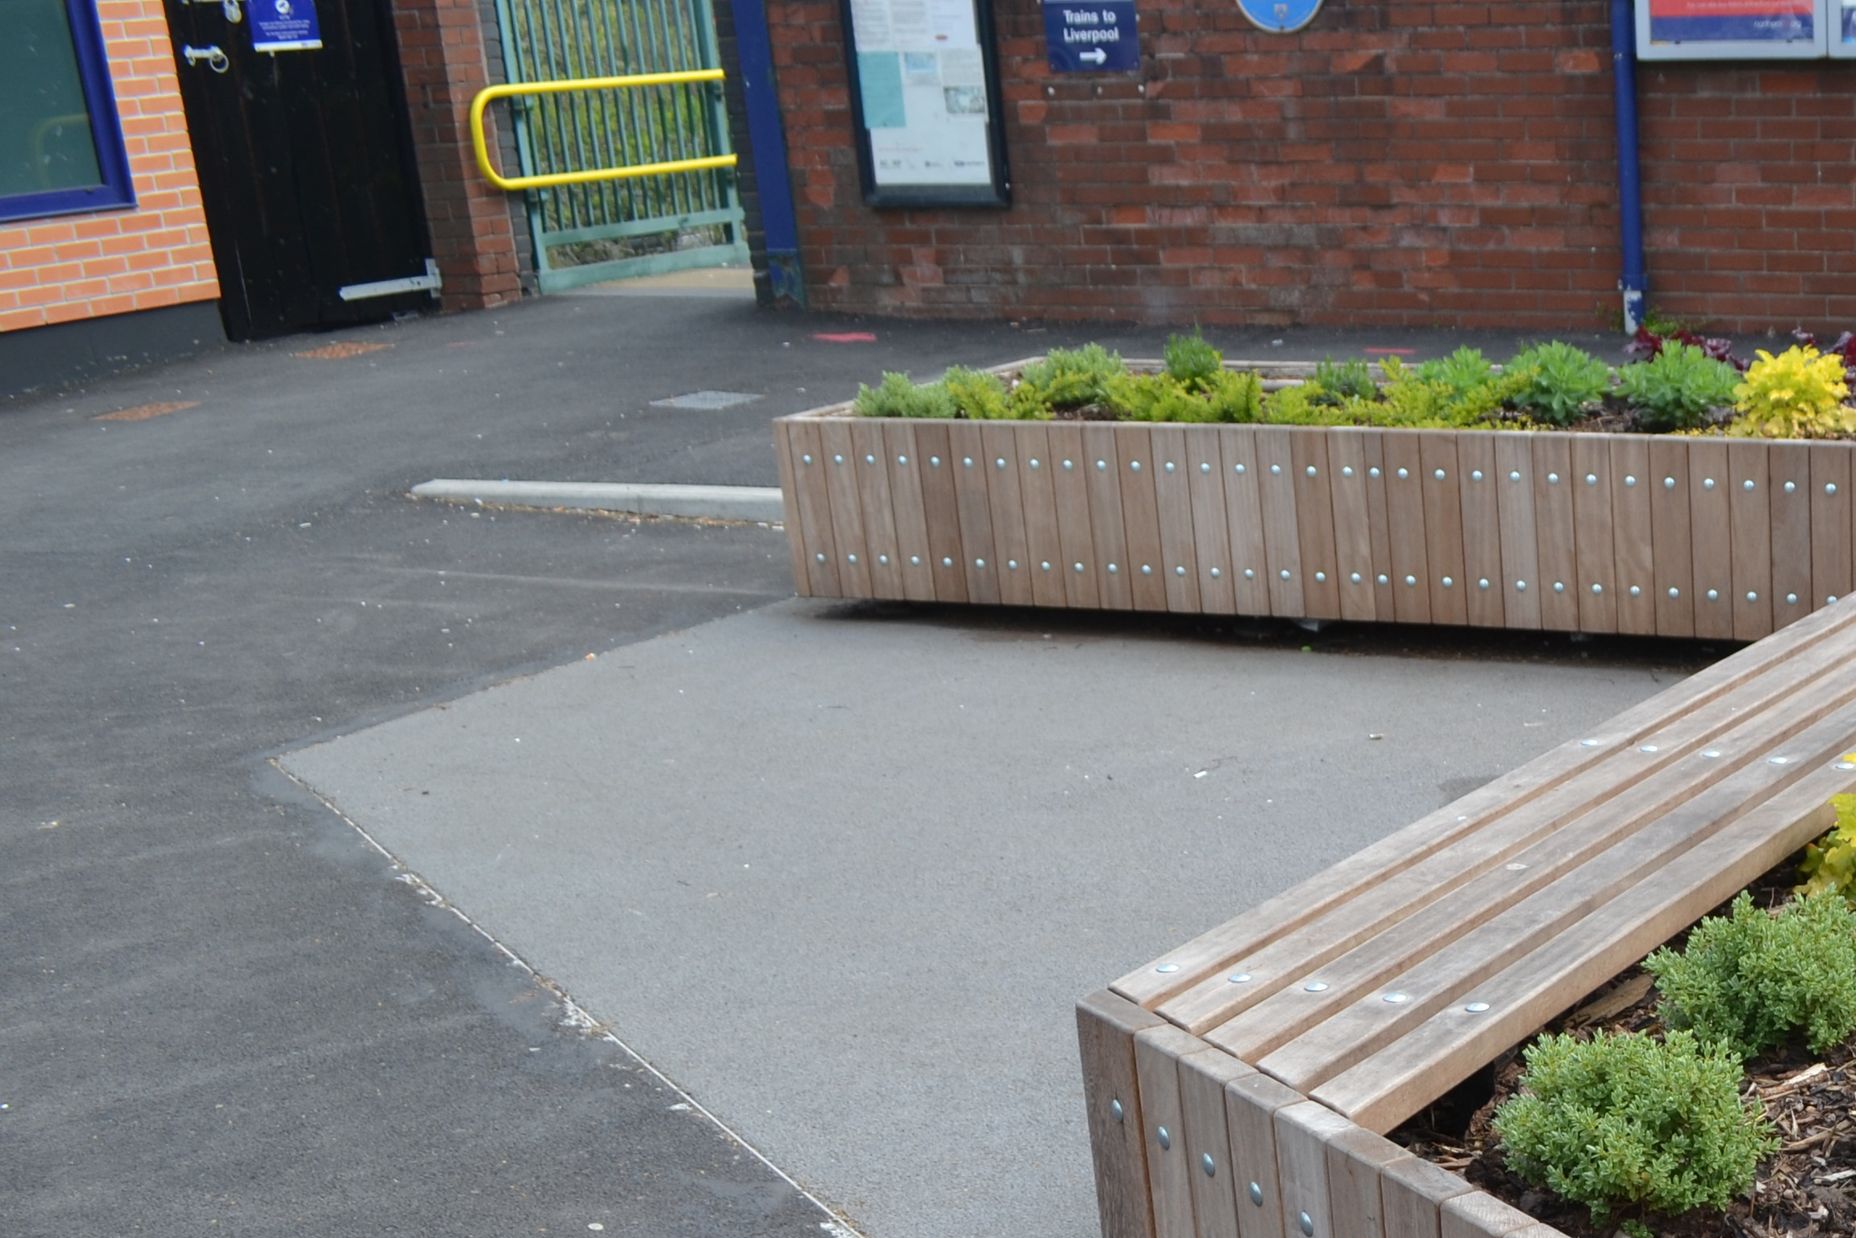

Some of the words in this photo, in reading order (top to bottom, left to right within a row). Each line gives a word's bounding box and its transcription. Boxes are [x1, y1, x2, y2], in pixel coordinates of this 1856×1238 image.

[1063, 9, 1099, 24] Trains
[1102, 9, 1117, 24] to
[1063, 26, 1119, 43] Liverpool
